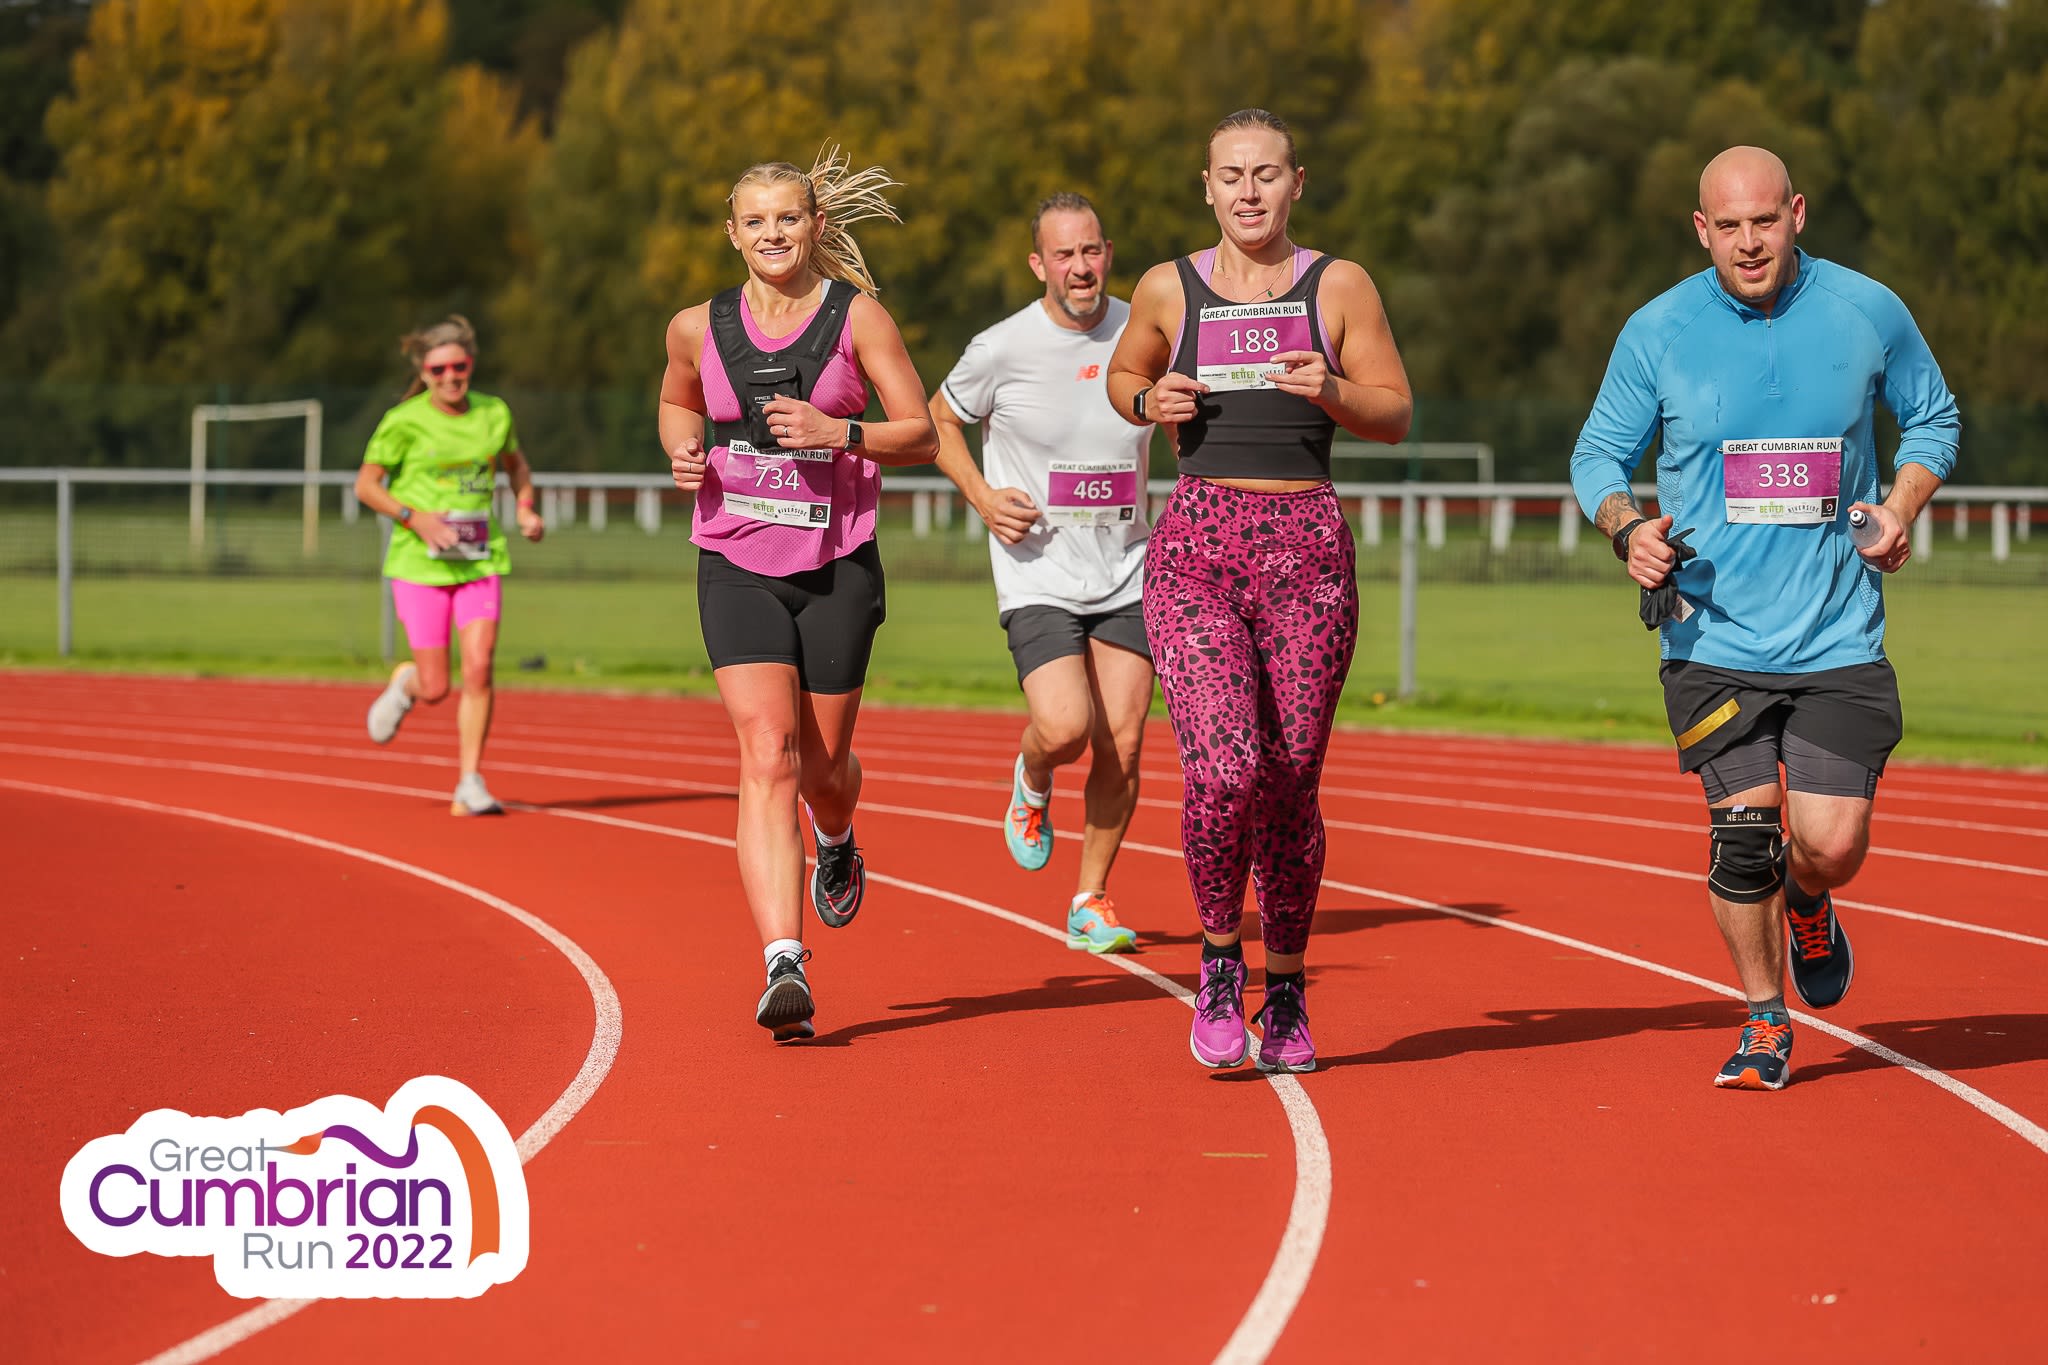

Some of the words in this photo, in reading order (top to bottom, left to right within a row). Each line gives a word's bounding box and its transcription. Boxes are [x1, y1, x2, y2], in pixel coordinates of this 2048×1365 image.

[1204, 309, 1230, 319] GREAT
[1231, 306, 1280, 317] CUMBRIAN
[1283, 305, 1302, 315] RUN
[1229, 327, 1280, 354] 188
[1727, 443, 1758, 452] GREAT
[1761, 442, 1814, 451] CUMBRIAN
[1816, 441, 1837, 450] RUN
[809, 451, 829, 460] RUN
[755, 465, 800, 491] 734
[1758, 463, 1809, 488] 338
[1073, 480, 1113, 500] 465
[1787, 504, 1820, 513] RIVERSIDE
[1726, 812, 1762, 822] NEENCA
